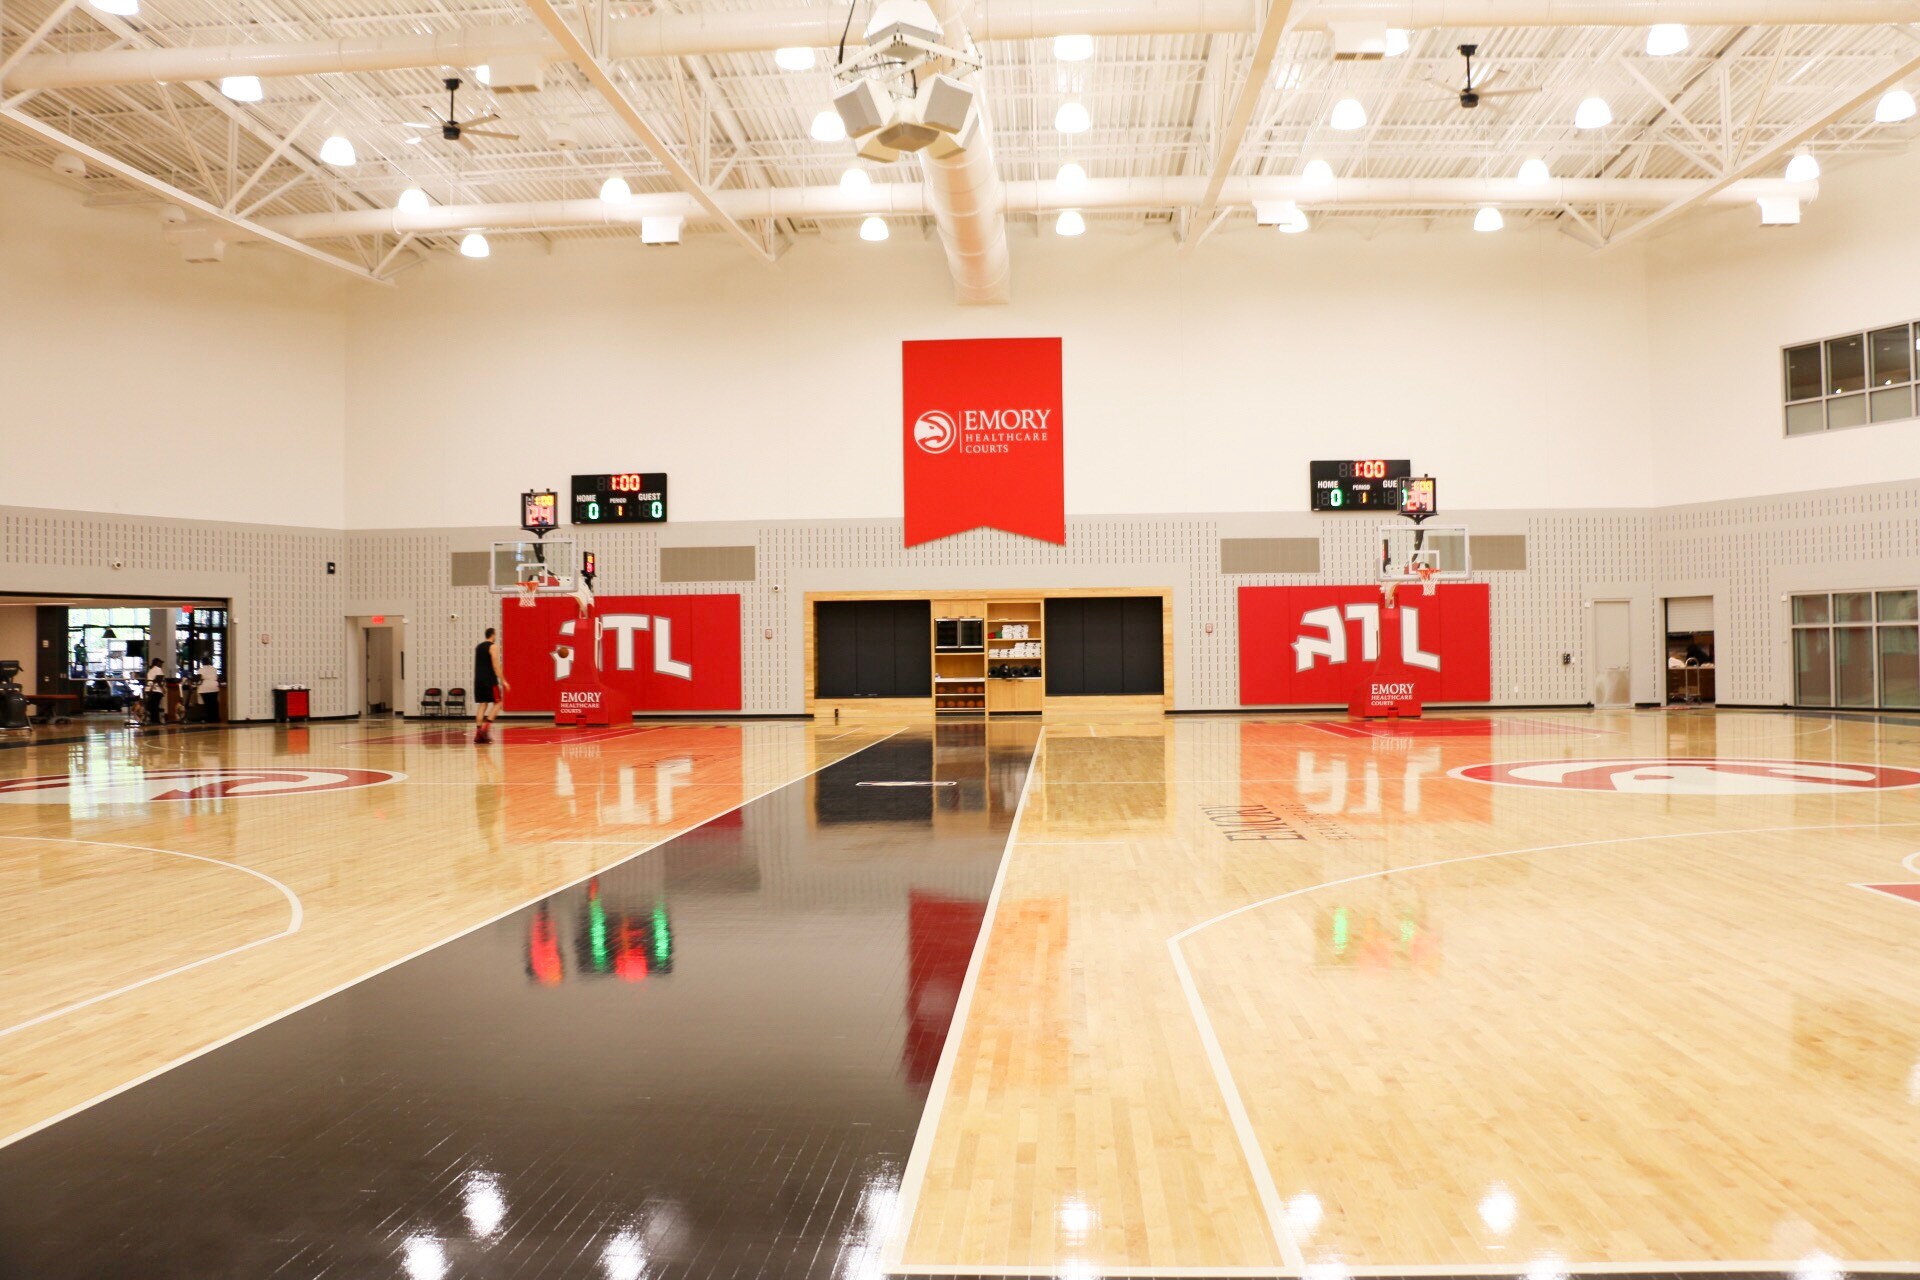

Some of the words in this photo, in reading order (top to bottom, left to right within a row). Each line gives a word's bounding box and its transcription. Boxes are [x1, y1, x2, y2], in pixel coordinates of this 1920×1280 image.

[964, 409, 1051, 430] EMORY
[965, 432, 1048, 442] HEALTHCARE
[965, 444, 1009, 453] COURTS
[1355, 461, 1385, 478] 1:00
[612, 474, 640, 491] 1:00
[1317, 481, 1339, 489] HOME
[576, 494, 597, 502] HOME
[638, 492, 662, 500] GUEST
[1330, 488, 1342, 507] 0
[588, 503, 599, 520] 0
[651, 501, 662, 518] 0
[1290, 603, 1441, 673] ATL
[561, 691, 602, 703] EMORY
[1371, 683, 1415, 695] EMORY
[1198, 804, 1307, 841] EMORY
